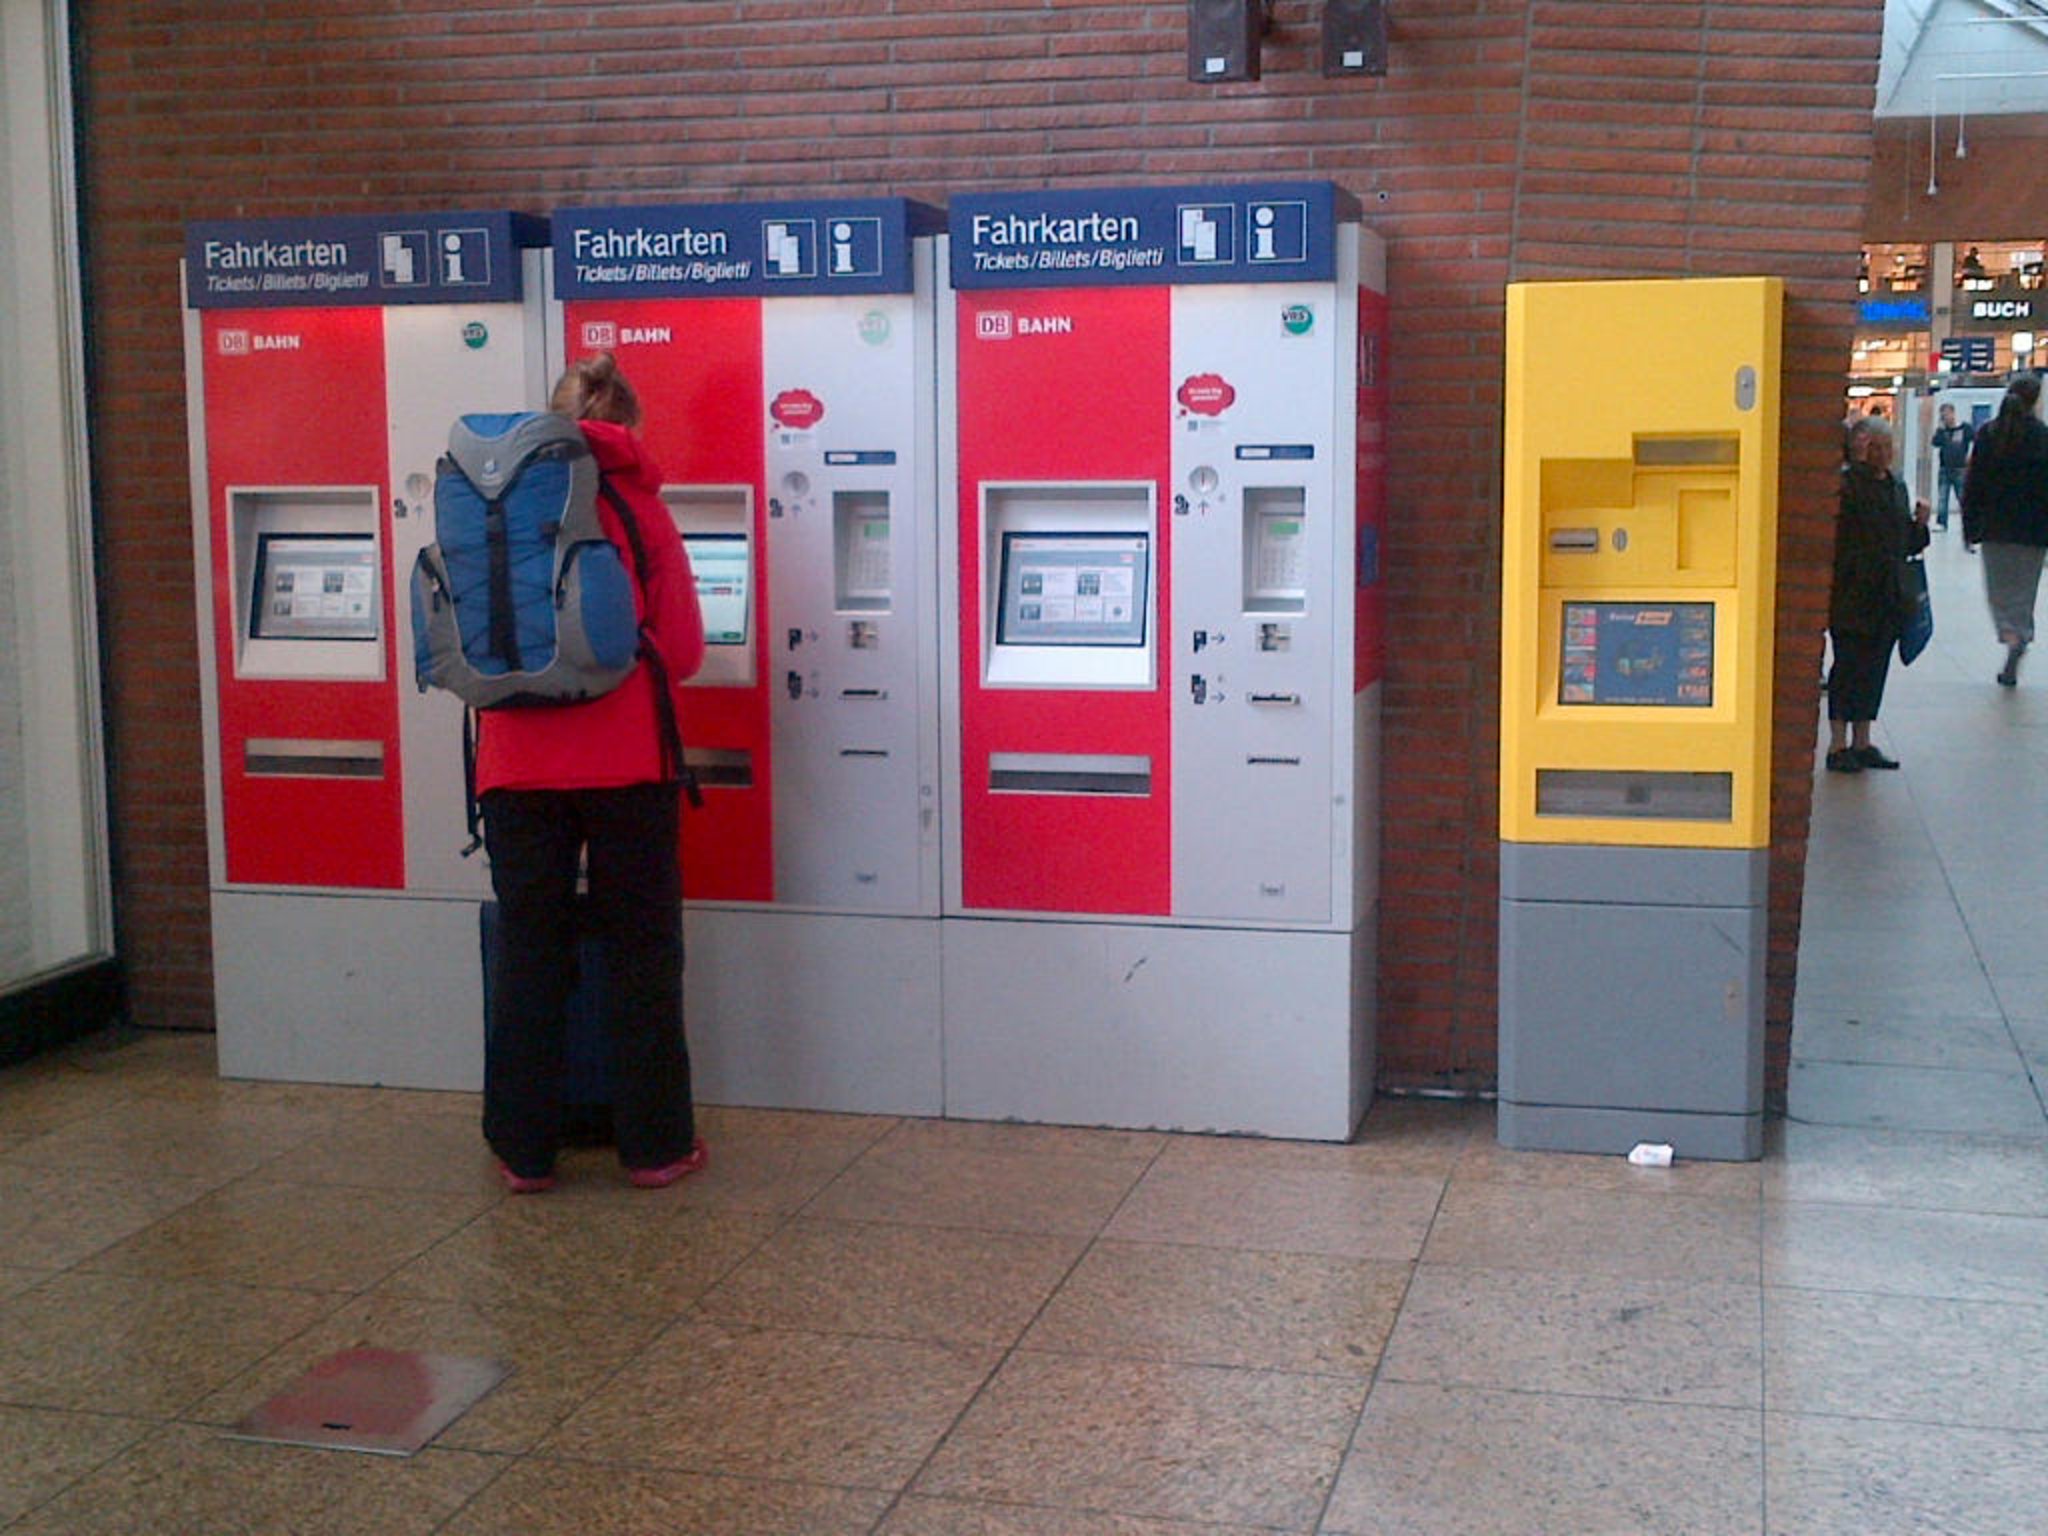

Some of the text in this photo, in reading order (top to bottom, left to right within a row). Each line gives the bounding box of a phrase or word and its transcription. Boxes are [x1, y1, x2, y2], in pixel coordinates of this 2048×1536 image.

[973, 212, 1138, 246] Fahrkarten
[574, 227, 728, 259] Fahrkarten
[204, 240, 347, 269] Fahrkarten
[1973, 301, 2030, 317] BUCH
[586, 326, 672, 344] DB BAHN
[980, 315, 1072, 336] DB BAHN
[254, 335, 300, 350] BAHN
